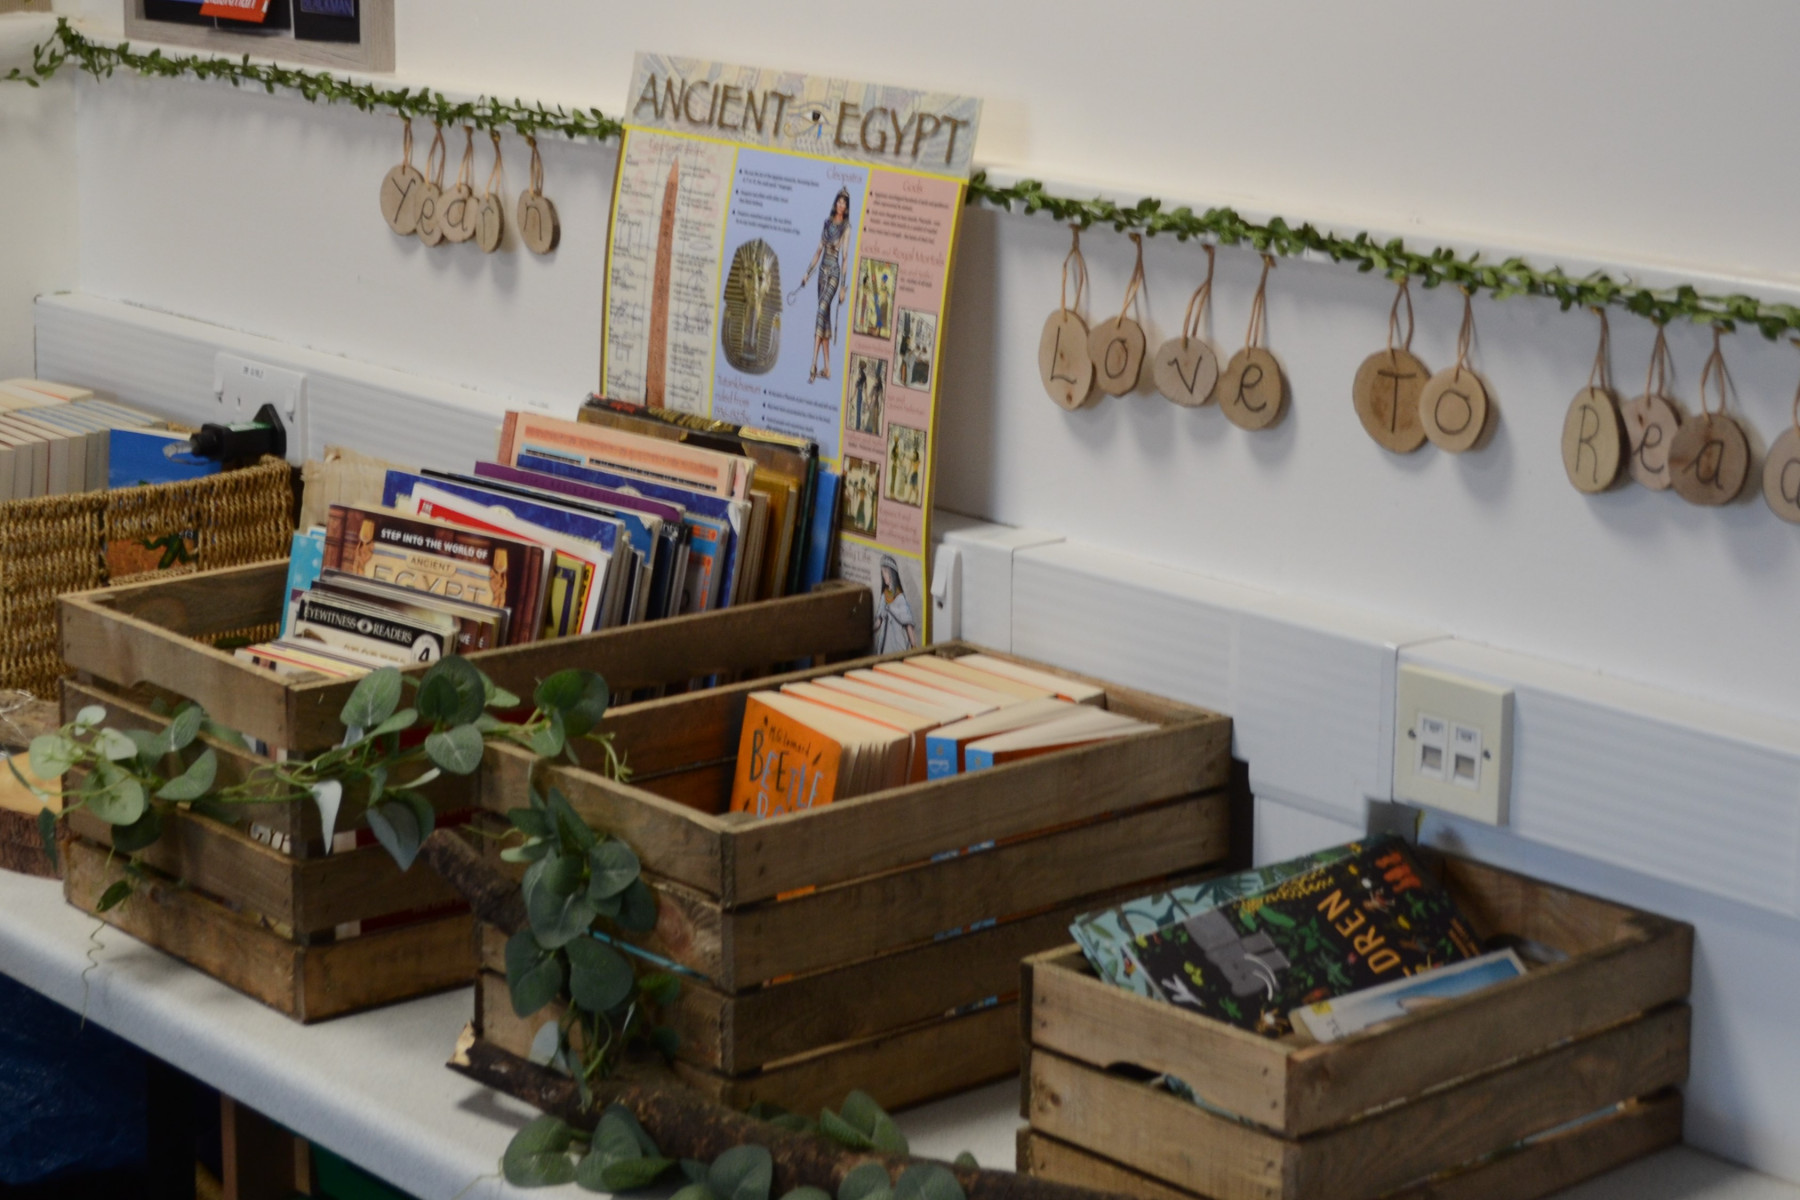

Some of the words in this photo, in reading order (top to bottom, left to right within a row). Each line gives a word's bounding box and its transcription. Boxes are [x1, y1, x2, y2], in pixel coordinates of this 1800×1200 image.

[632, 72, 794, 138] ANCIENT
[834, 101, 969, 165] EGYPT
[380, 527, 402, 541] STEP
[402, 533, 424, 546] INTO
[425, 537, 442, 550] THE
[443, 541, 475, 556] WORLD
[476, 548, 489, 560] OF
[410, 555, 452, 575] ANCIENT
[304, 605, 357, 631] EYEWITNESS
[371, 622, 413, 644] READERS
[418, 647, 431, 663] 4
